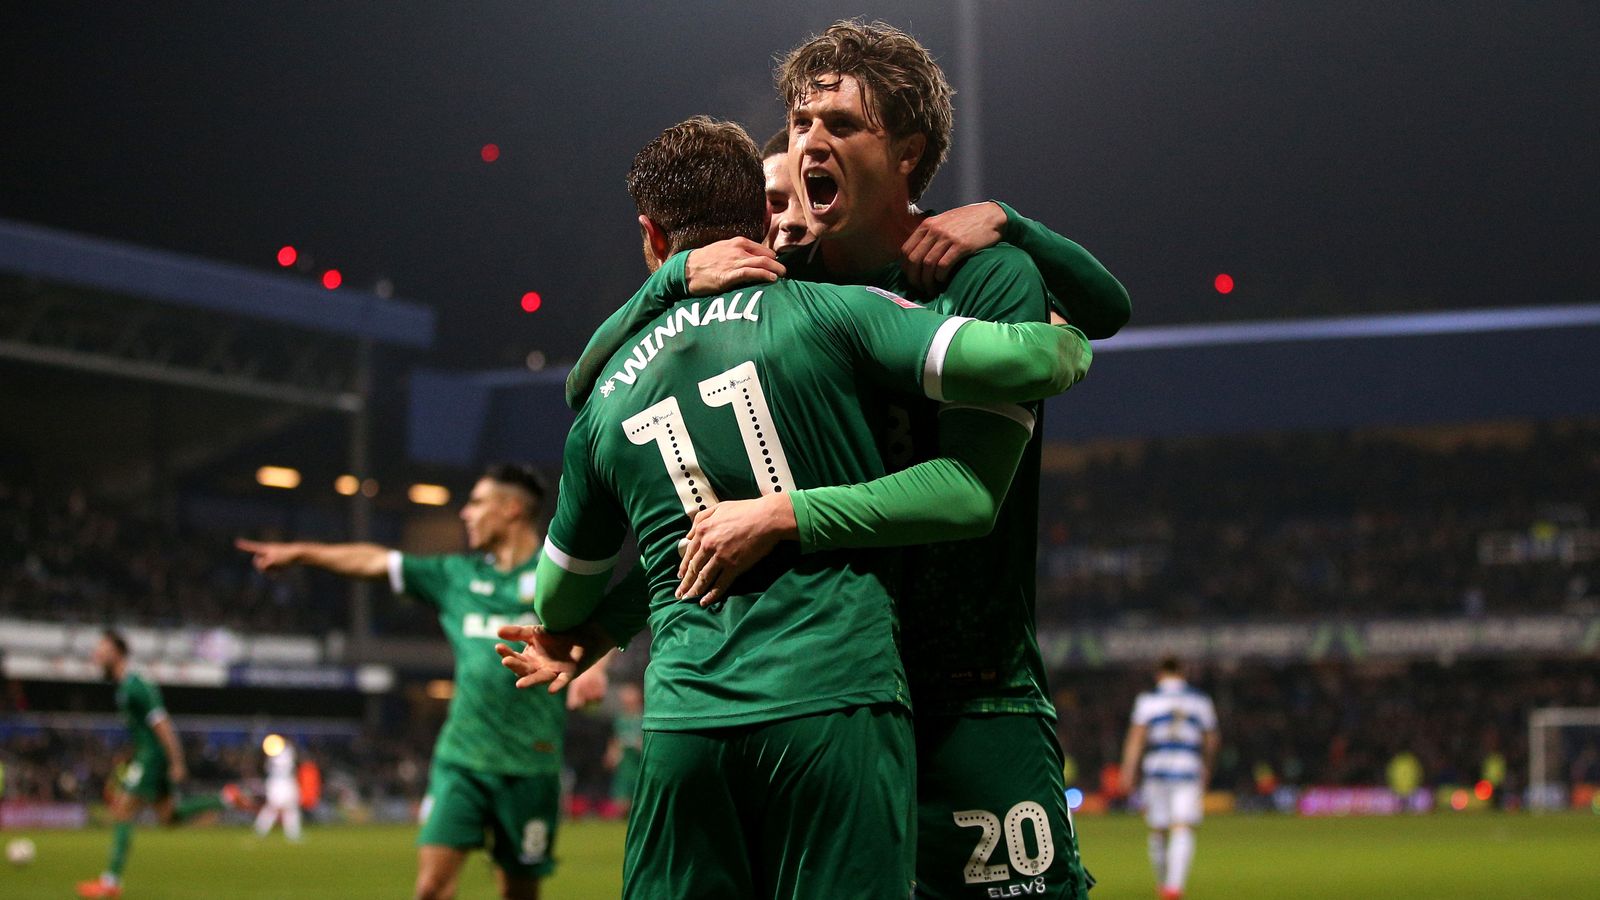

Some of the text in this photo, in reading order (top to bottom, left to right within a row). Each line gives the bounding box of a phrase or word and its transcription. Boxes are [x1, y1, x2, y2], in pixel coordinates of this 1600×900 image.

[613, 290, 764, 385] WINNALL
[621, 360, 798, 522] 11
[953, 801, 1055, 884] 20
[988, 876, 1046, 899] ELEV8
